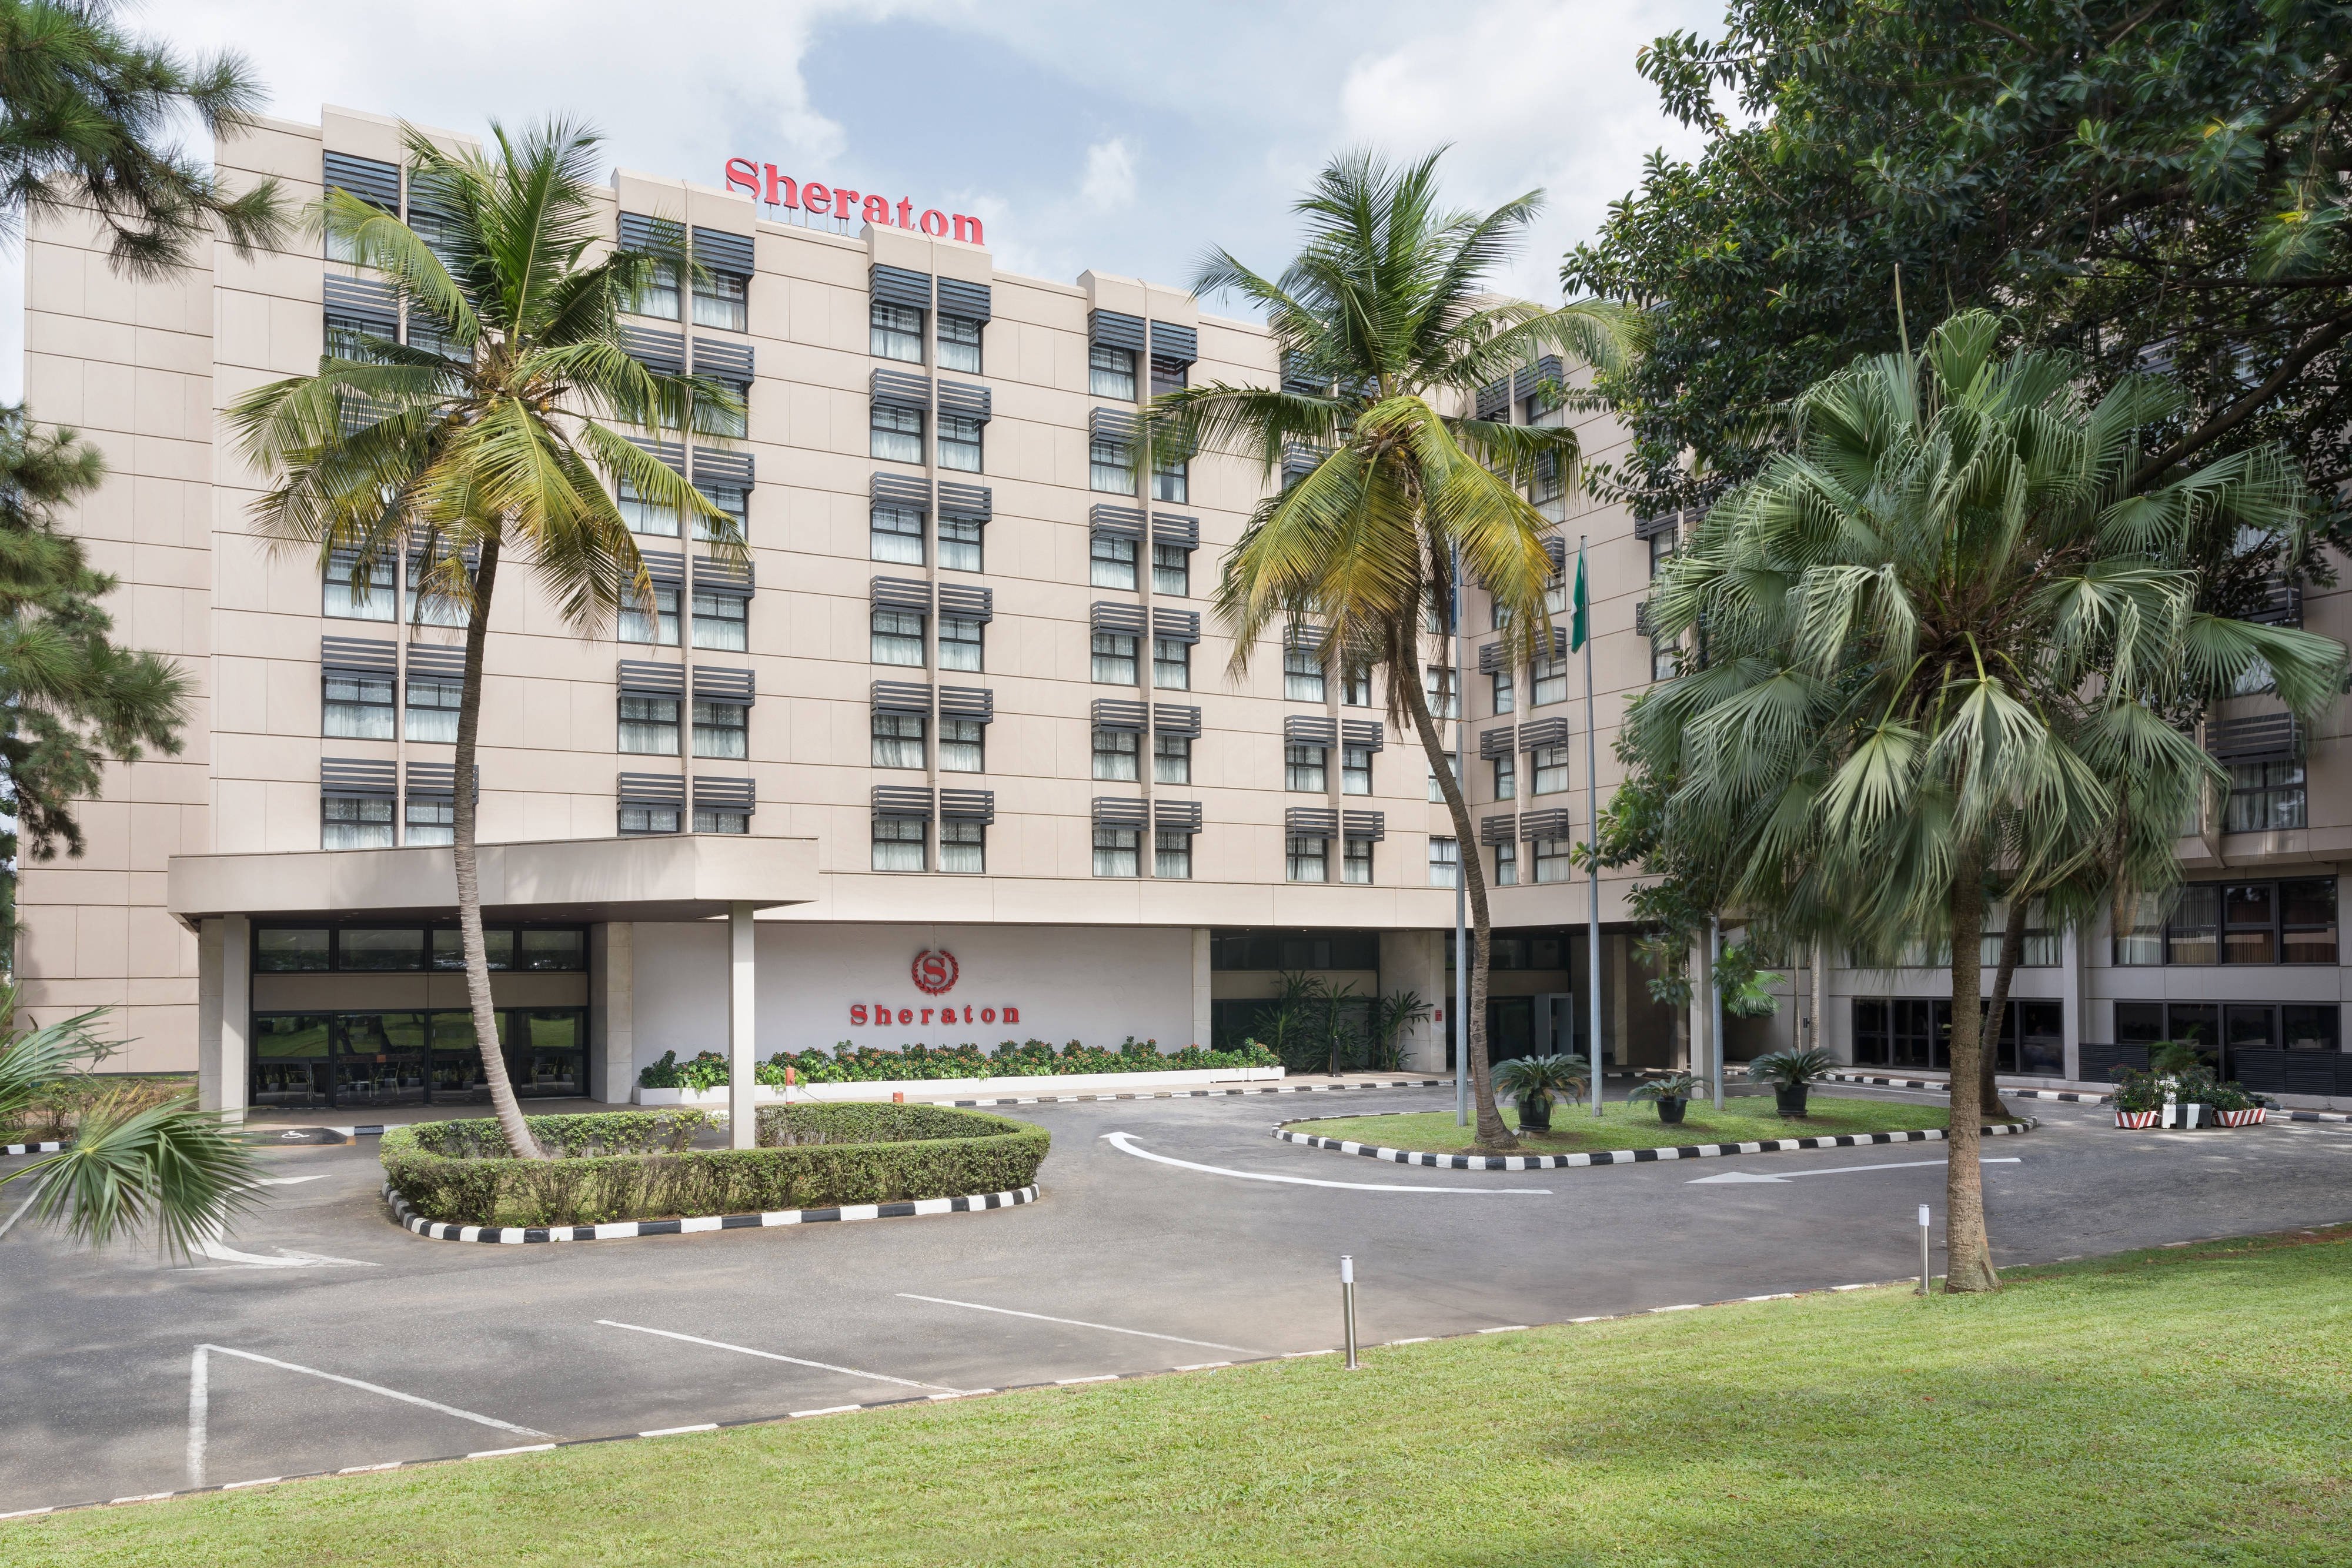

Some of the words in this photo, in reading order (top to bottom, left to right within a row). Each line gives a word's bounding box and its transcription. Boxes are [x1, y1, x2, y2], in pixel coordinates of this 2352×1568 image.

[725, 157, 984, 246] Sheraton
[923, 957, 947, 985] S
[850, 1004, 1020, 1025] Sheraton
